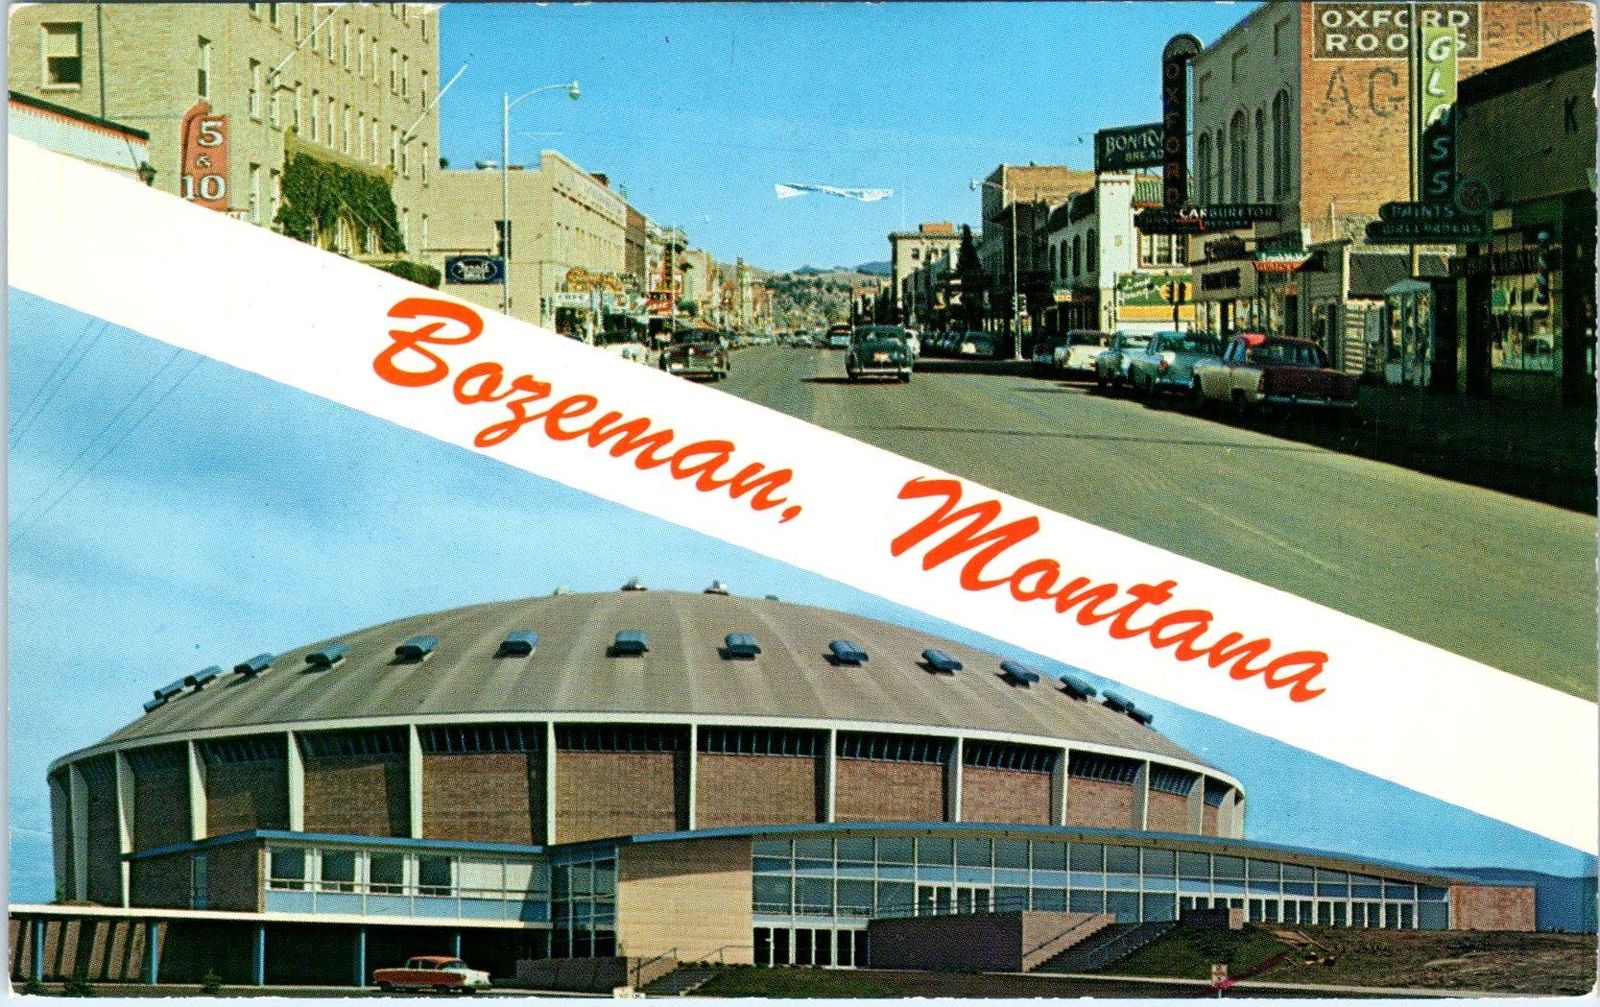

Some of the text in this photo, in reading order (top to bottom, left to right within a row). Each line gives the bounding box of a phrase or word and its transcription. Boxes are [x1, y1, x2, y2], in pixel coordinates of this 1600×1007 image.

[1321, 9, 1470, 29] OXFORD
[1324, 33, 1467, 52] ROOS
[1428, 35, 1453, 194] GLASS
[198, 120, 223, 148] 5
[183, 174, 227, 201] 10
